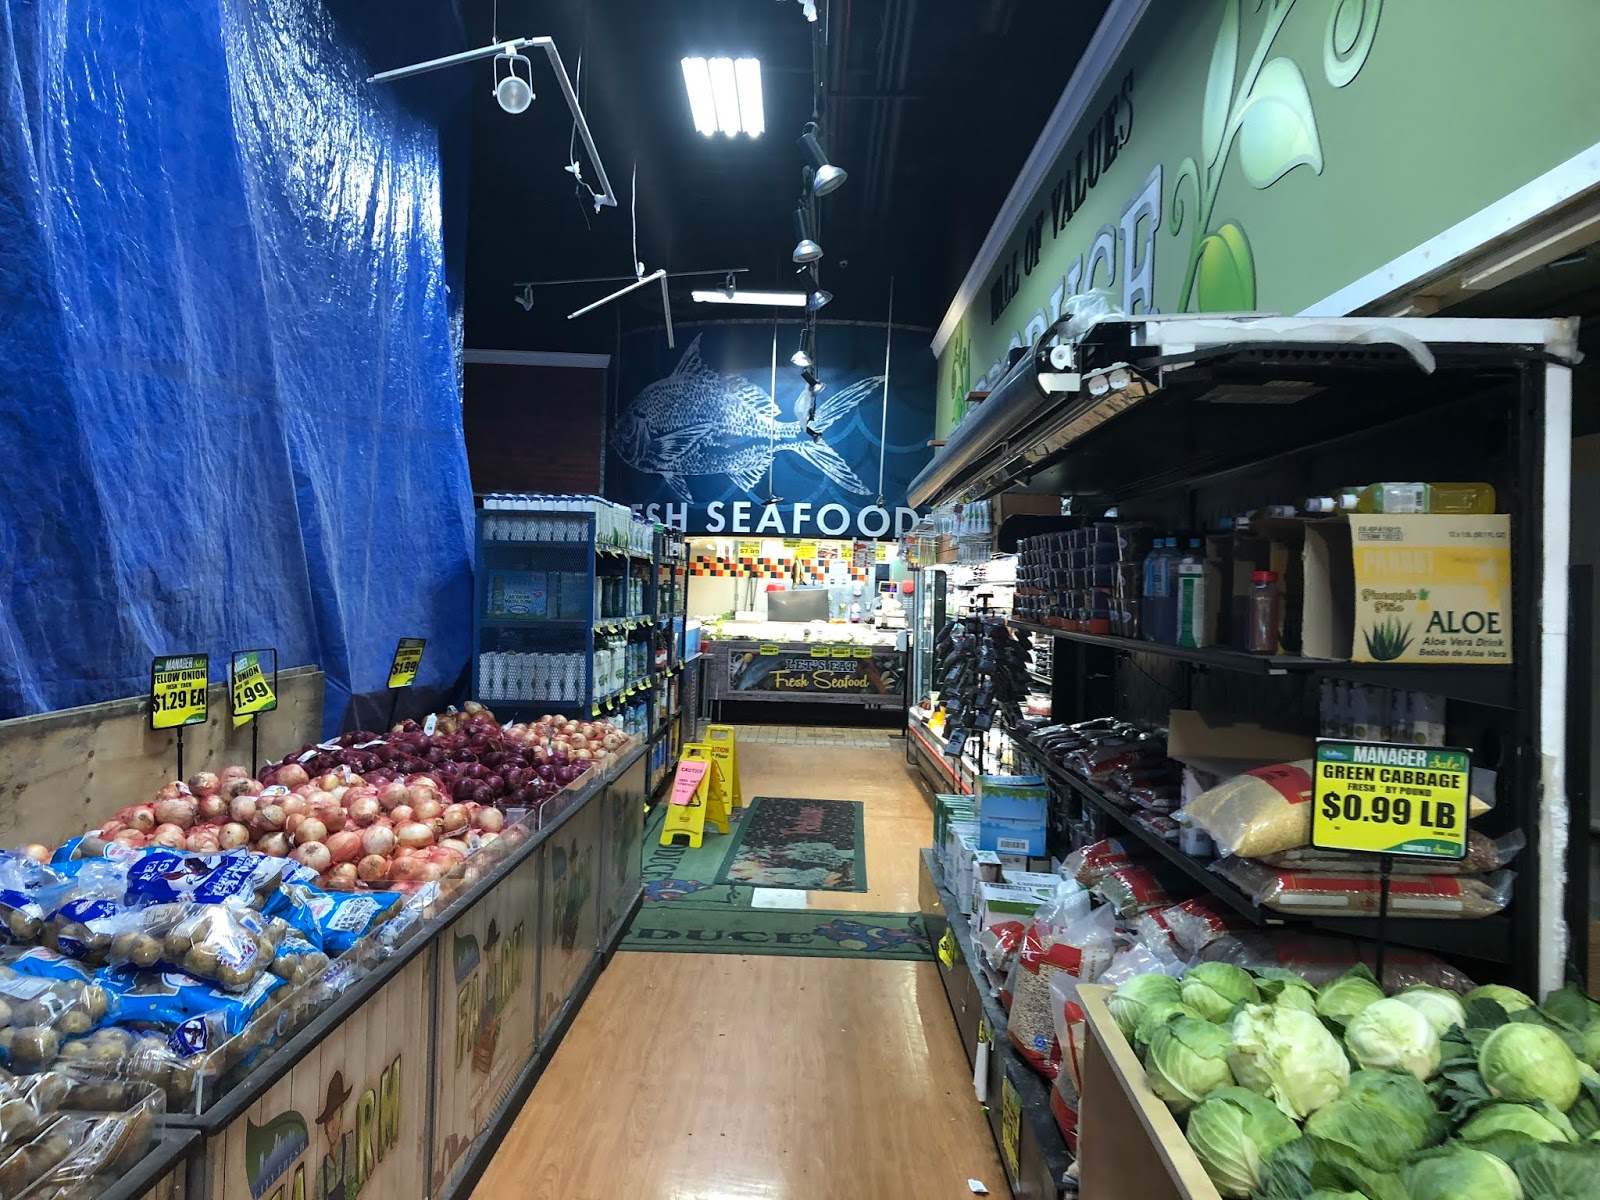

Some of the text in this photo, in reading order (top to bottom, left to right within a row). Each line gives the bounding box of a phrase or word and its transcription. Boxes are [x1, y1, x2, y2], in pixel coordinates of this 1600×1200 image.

[1024, 210, 1044, 276] OF
[1050, 68, 1134, 239] VALUES
[705, 501, 919, 538] SEAFOOD
[1425, 610, 1502, 634] ALOE
[1422, 637, 1504, 647] Aloe Vera Drink
[165, 657, 194, 671] MANAGER
[237, 665, 260, 682] ONION
[785, 659, 857, 673] LET'S EAT
[181, 670, 206, 681] ONION
[769, 670, 870, 689] Fresh Seafood
[153, 688, 206, 713] $1.29 EA
[234, 681, 269, 709] 1.99
[1353, 746, 1428, 767] MANAGER
[1323, 764, 1461, 789] GREEN CABBAGE
[1347, 782, 1432, 797] FRESH BY POUND
[1322, 791, 1456, 829] $0.99 LB
[622, 928, 814, 944] DUCE
